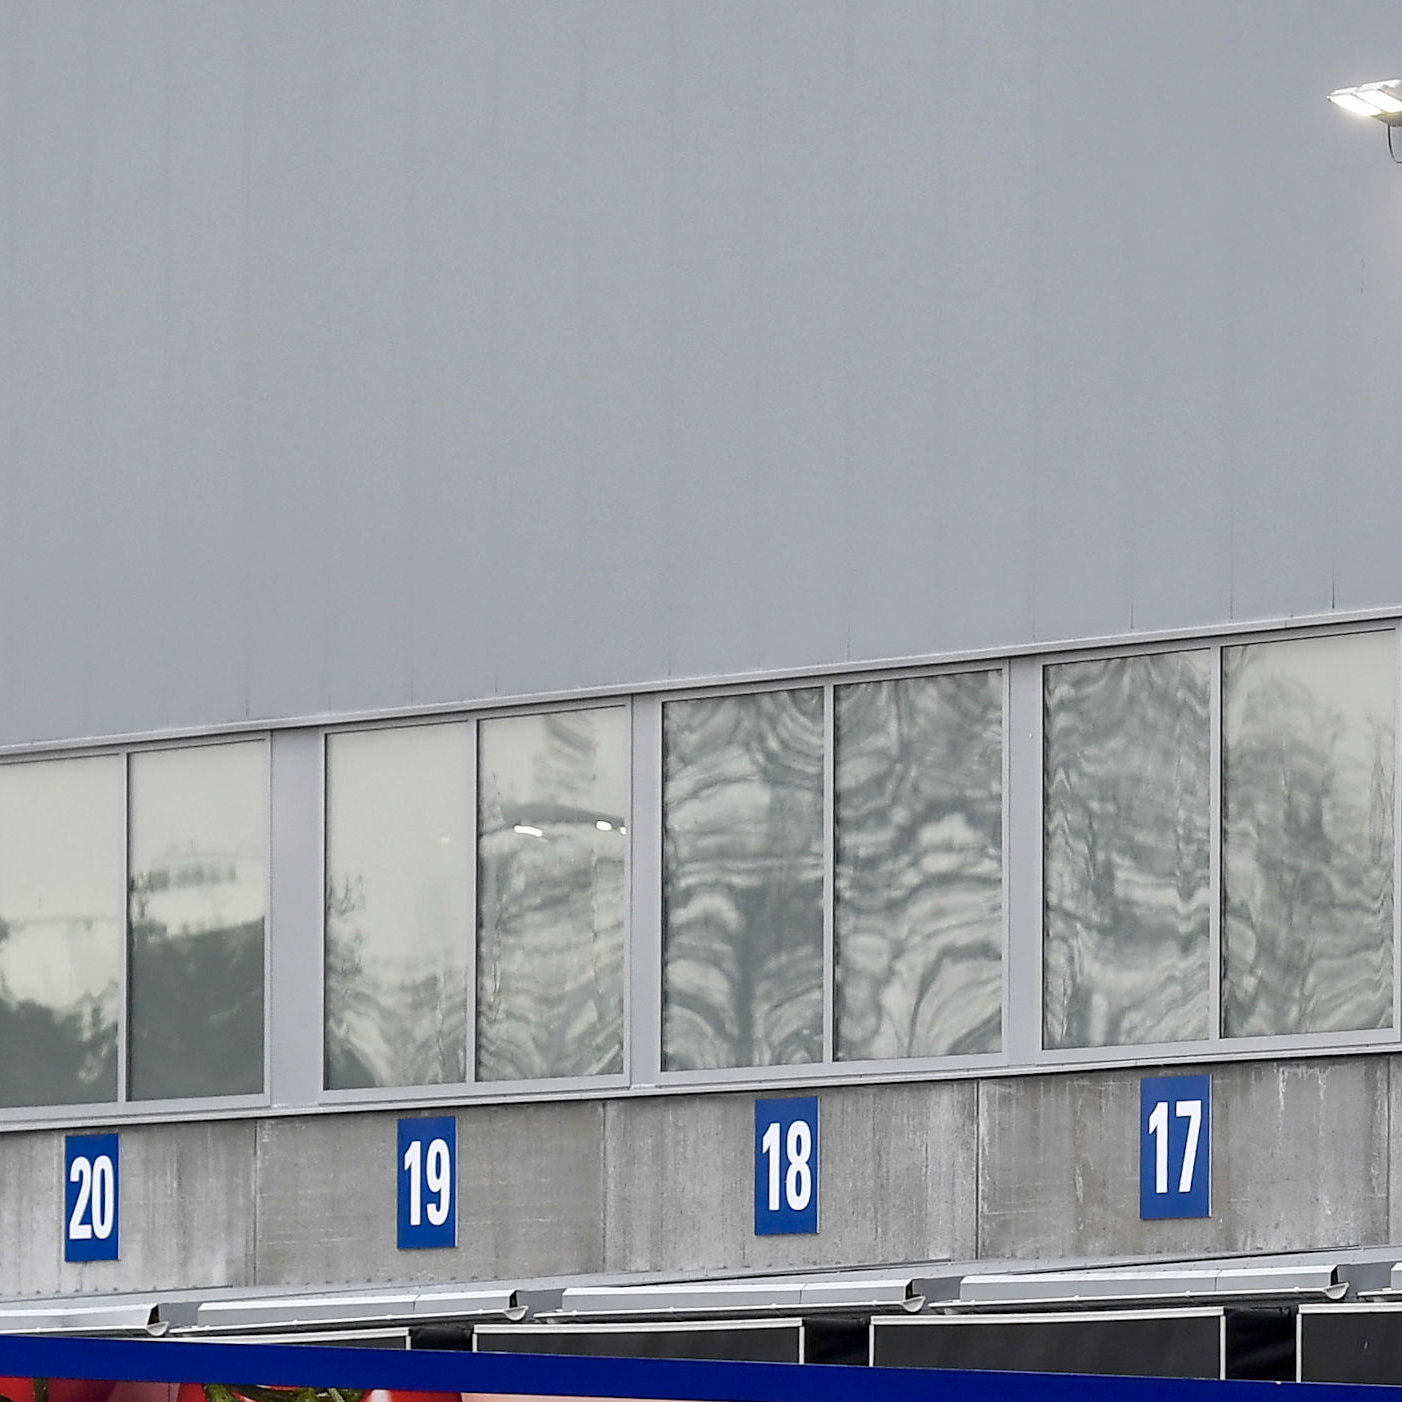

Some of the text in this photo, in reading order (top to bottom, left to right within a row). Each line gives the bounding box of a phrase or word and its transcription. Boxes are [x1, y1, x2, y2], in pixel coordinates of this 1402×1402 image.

[404, 1138, 451, 1226] 19
[762, 1120, 812, 1211] 18
[1148, 1099, 1202, 1194] 17
[69, 1155, 115, 1240] 20
